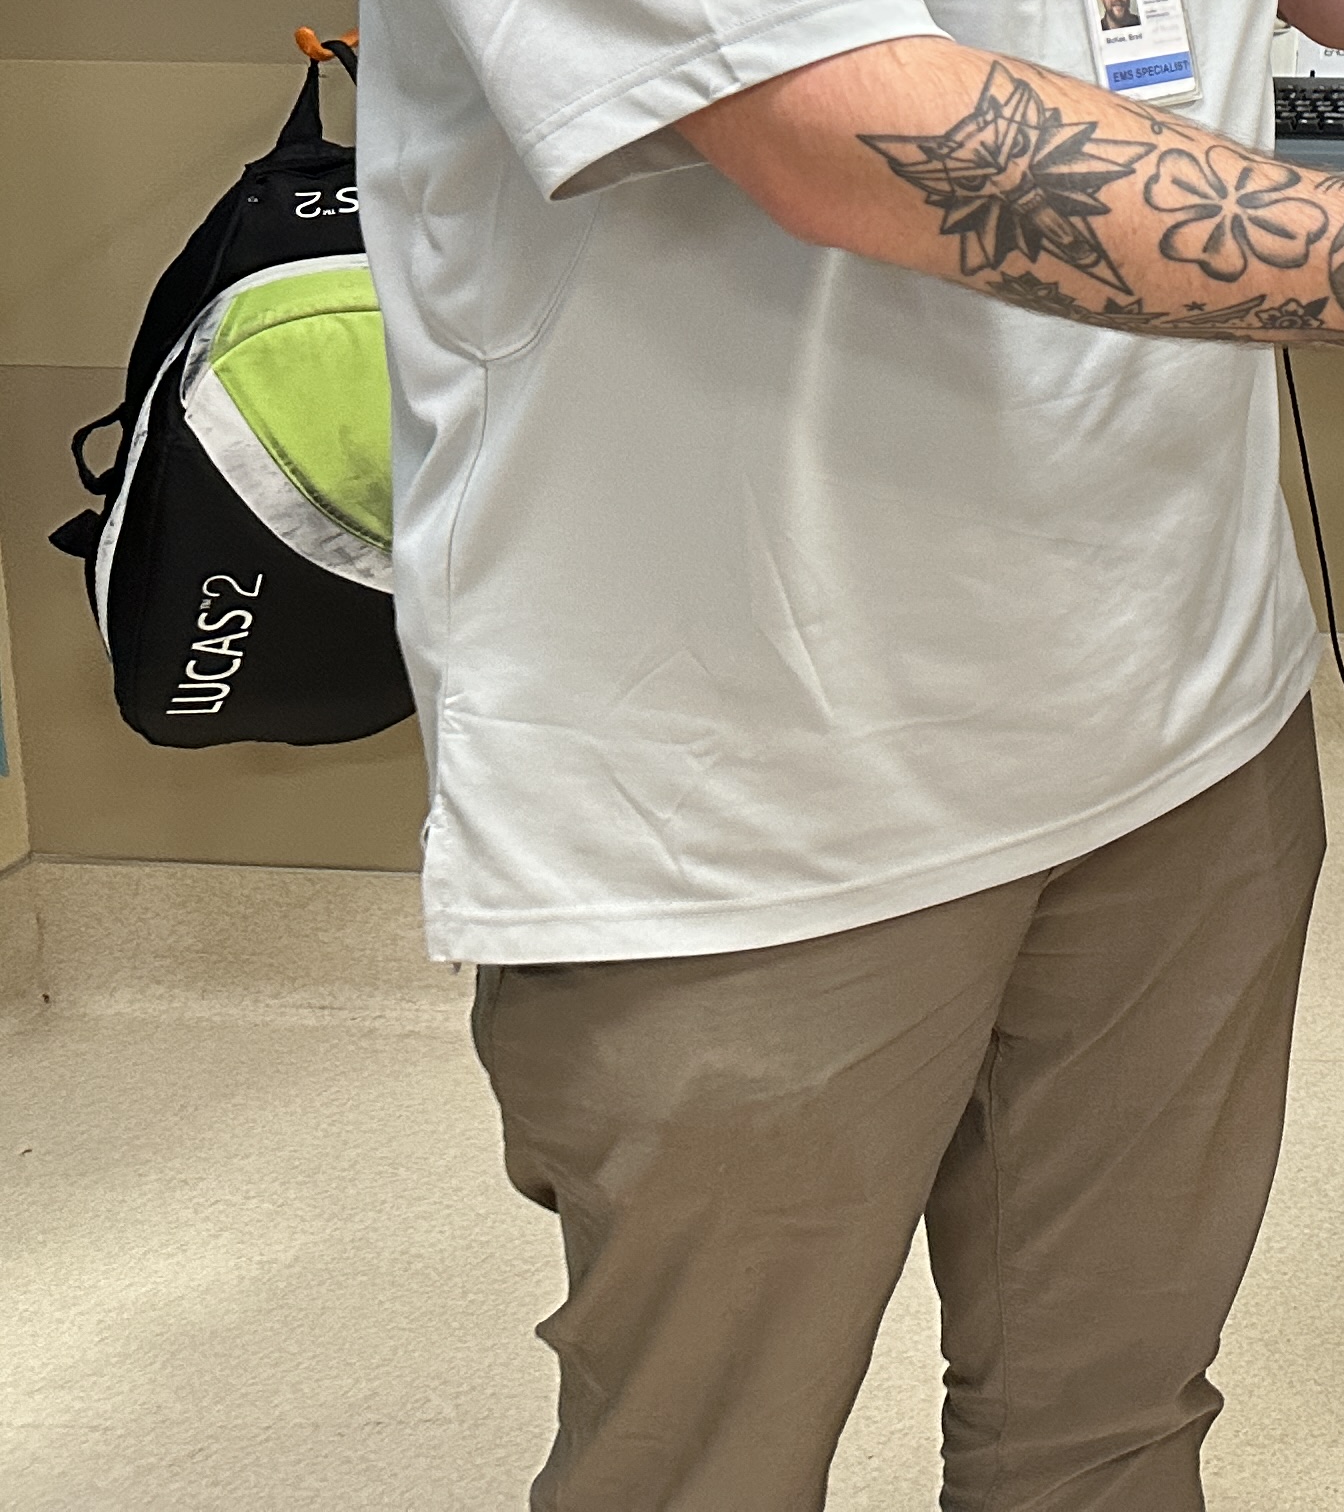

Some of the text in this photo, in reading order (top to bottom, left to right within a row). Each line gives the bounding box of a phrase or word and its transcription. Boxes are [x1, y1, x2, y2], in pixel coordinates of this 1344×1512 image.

[1113, 59, 1189, 83] EMS SPECIALIST
[294, 191, 322, 219] 2
[202, 573, 263, 597] 2
